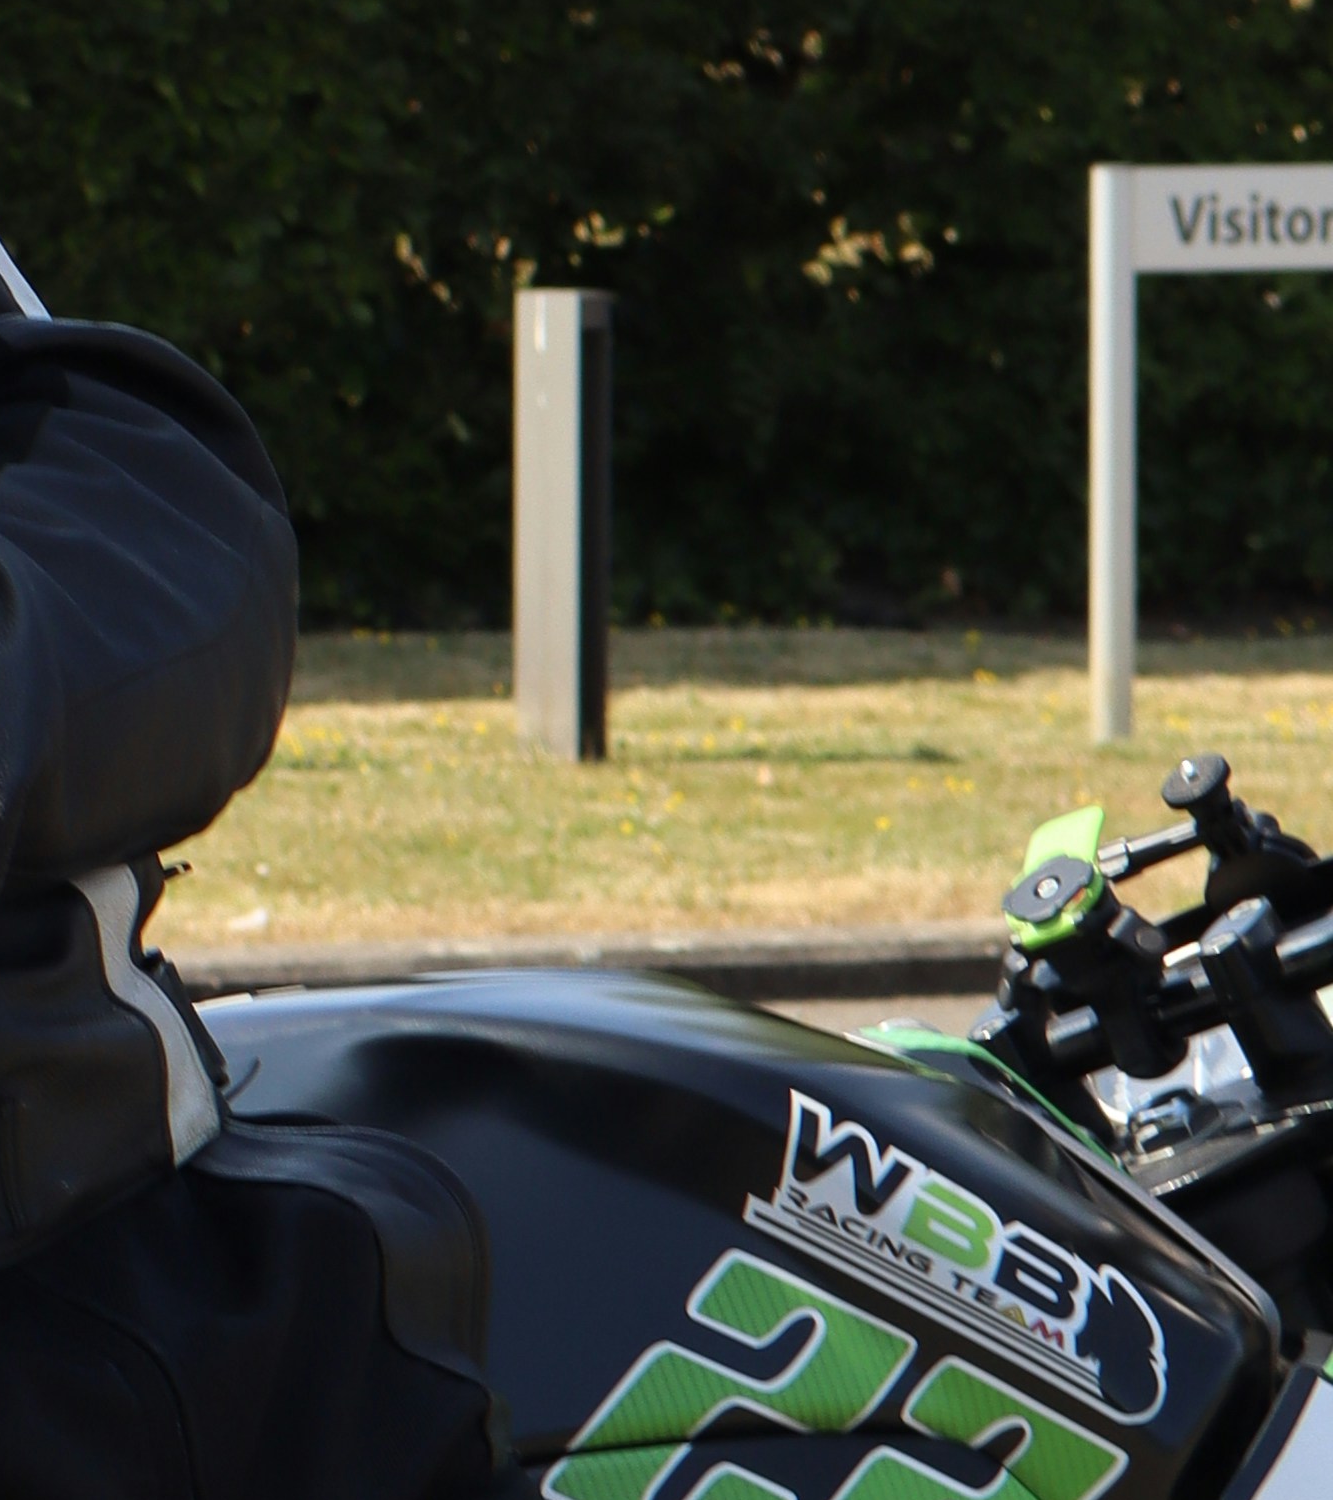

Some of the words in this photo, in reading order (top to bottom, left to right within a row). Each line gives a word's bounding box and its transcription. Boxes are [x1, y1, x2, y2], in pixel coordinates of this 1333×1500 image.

[785, 1184, 933, 1274] RACING
[950, 1270, 1065, 1351] TEAM
[790, 1090, 1081, 1322] WBB
